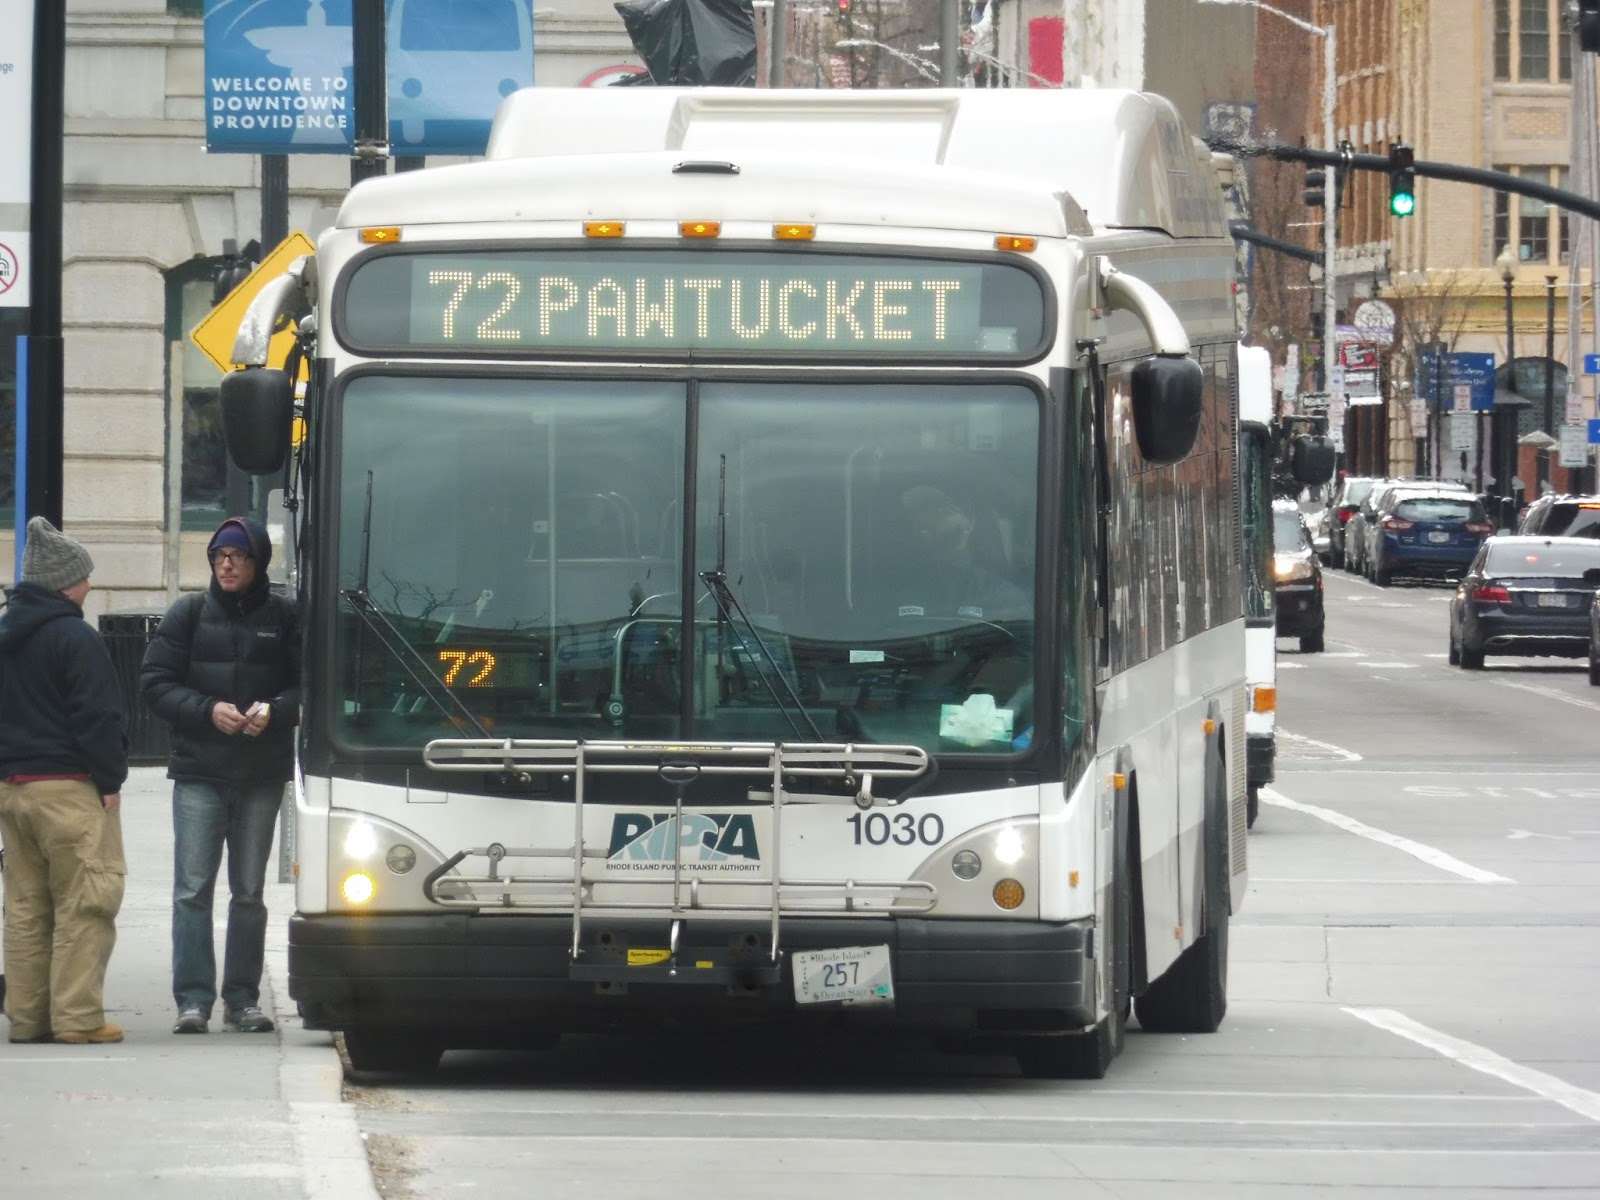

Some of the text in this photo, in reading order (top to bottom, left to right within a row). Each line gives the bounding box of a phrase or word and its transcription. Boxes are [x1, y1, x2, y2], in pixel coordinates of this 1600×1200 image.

[212, 77, 348, 91] WELCOME TO
[213, 96, 346, 111] DOWNTOWN
[213, 115, 347, 129] PROVIDENCE
[429, 270, 961, 342] 72 PAWTUCKET
[439, 651, 496, 688] 72
[608, 813, 760, 861] RIPTA
[846, 812, 944, 845] 1030
[606, 863, 761, 871] RHODE ISLAND PUBIC TRANSIT AUTHORITY
[823, 961, 860, 988] 257
